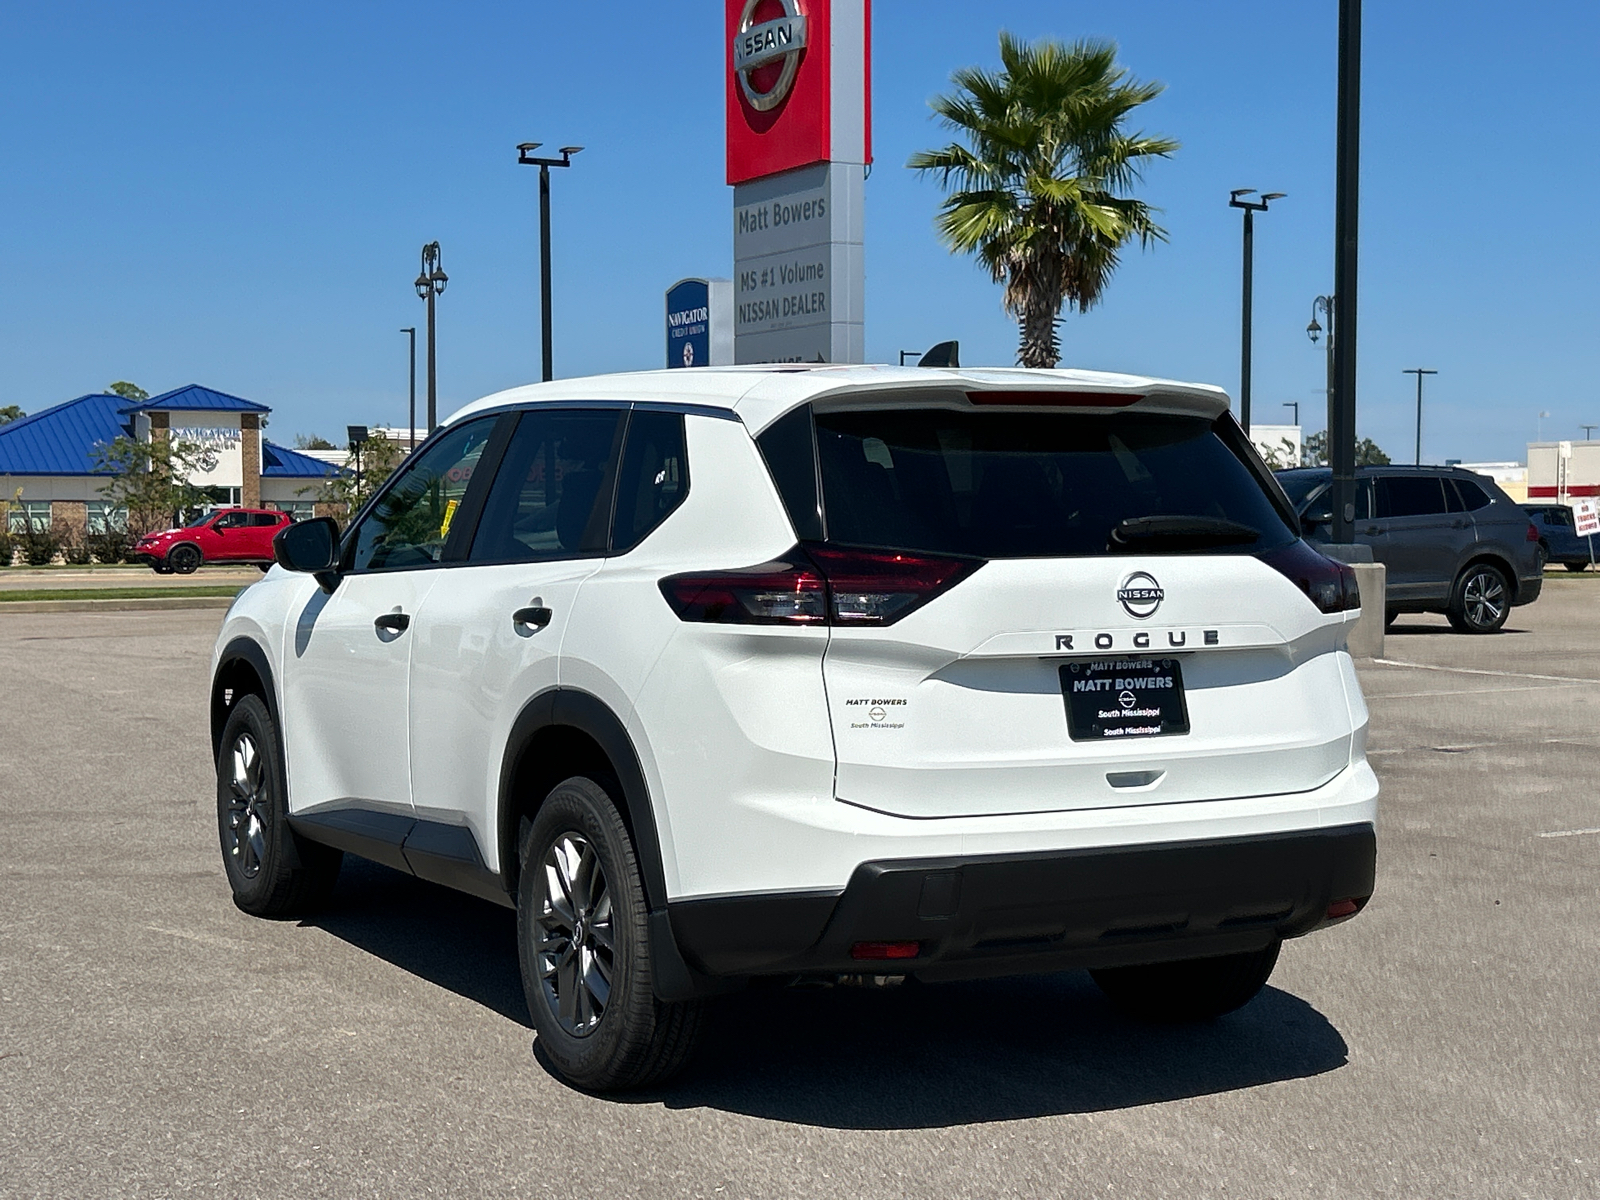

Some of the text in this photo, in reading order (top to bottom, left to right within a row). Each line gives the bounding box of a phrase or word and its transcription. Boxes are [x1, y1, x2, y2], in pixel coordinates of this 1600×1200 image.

[739, 198, 826, 234] Matt Bowers
[741, 261, 824, 292] MS #1 Volume
[739, 292, 826, 324] NISSAN DEALER
[669, 306, 708, 327] NAVIGATOR
[170, 427, 241, 437] NAVIGATOR
[1118, 589, 1164, 599] NISSAN
[1055, 630, 1219, 650] ROGUE
[1090, 660, 1153, 671] MATT BOWERS
[1073, 676, 1173, 692] MATT BOWERS
[870, 698, 908, 706] BOWERS
[1098, 707, 1160, 718] South Mississippi
[1103, 725, 1162, 736] South Mississippi
